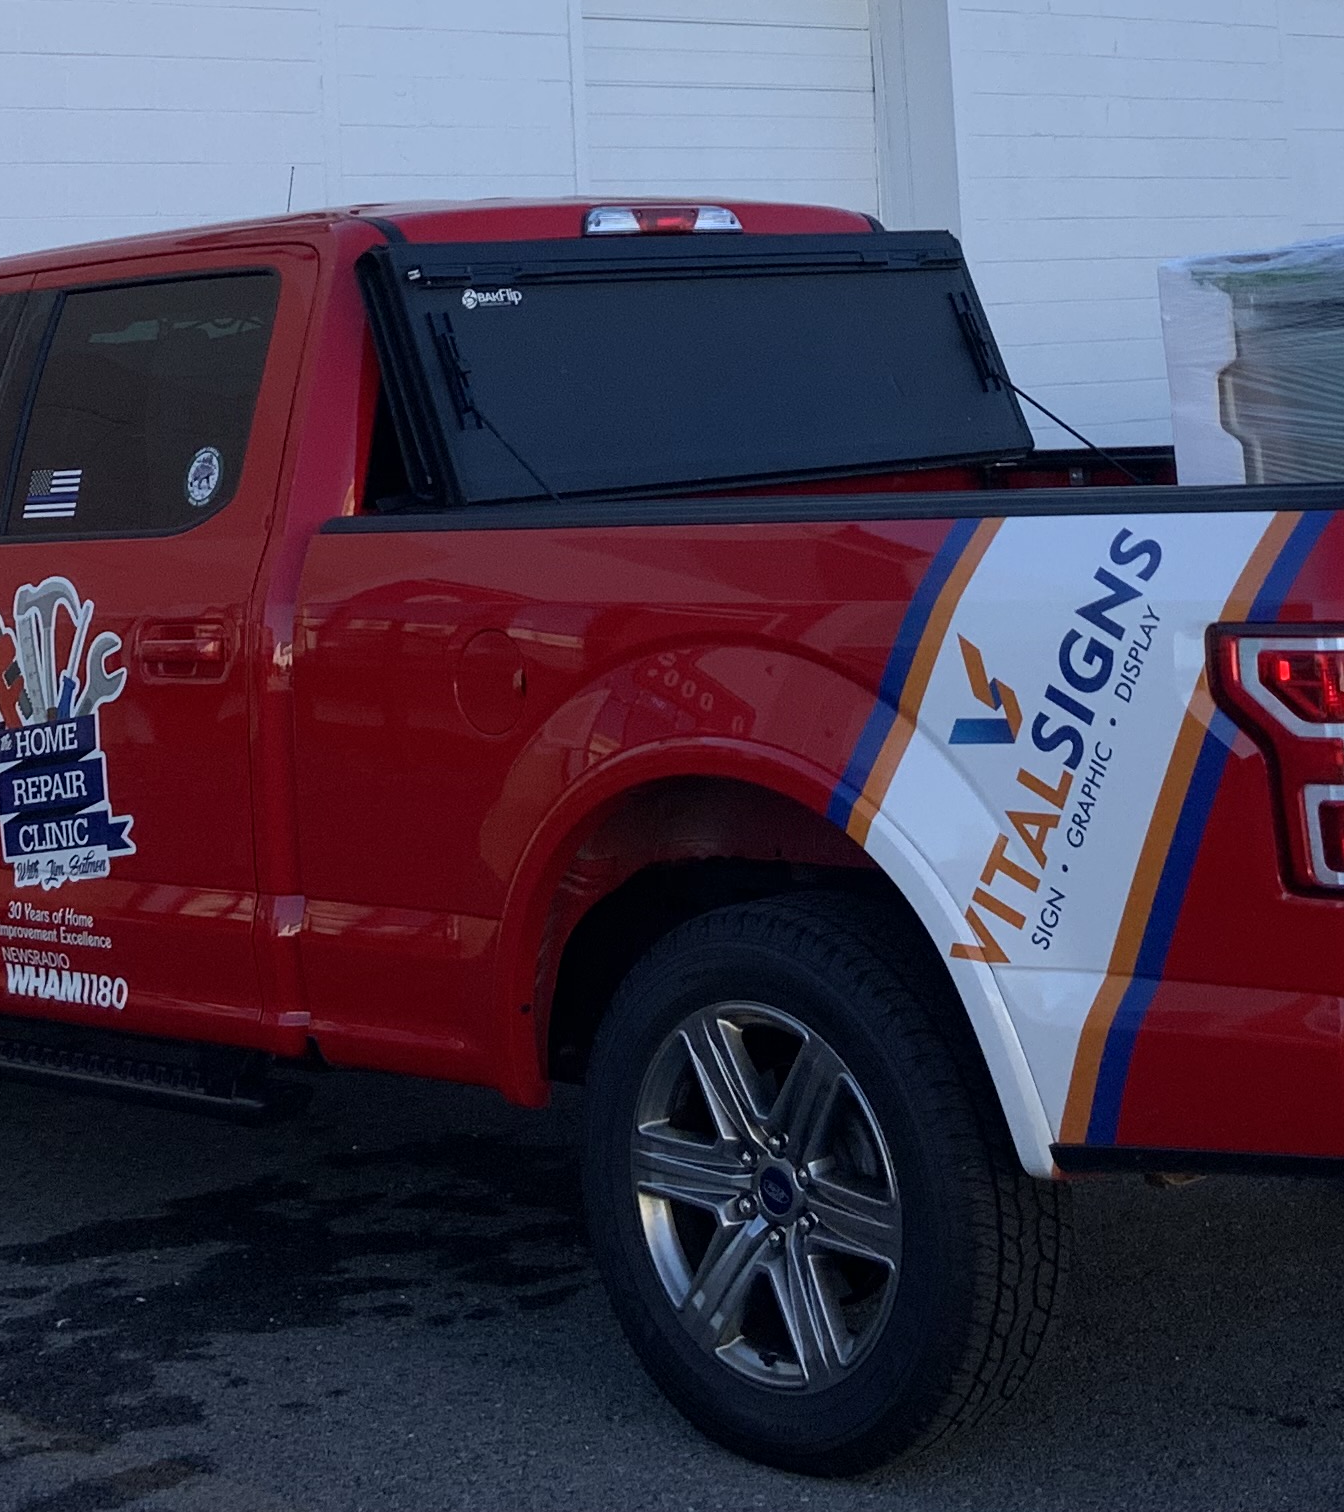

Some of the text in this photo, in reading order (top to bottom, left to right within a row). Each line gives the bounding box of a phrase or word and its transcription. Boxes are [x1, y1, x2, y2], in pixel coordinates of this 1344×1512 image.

[15, 722, 79, 758] HOME
[949, 528, 1163, 964] VITALSIGNS
[12, 770, 87, 806] REPAIR
[1031, 604, 1161, 951] SIGN GRAPHIC DISPLAY
[18, 818, 89, 853] CLINIC
[8, 900, 94, 928] 30 Years of Home
[60, 926, 113, 949] Excellence
[1, 946, 70, 969] NEWSRADIO
